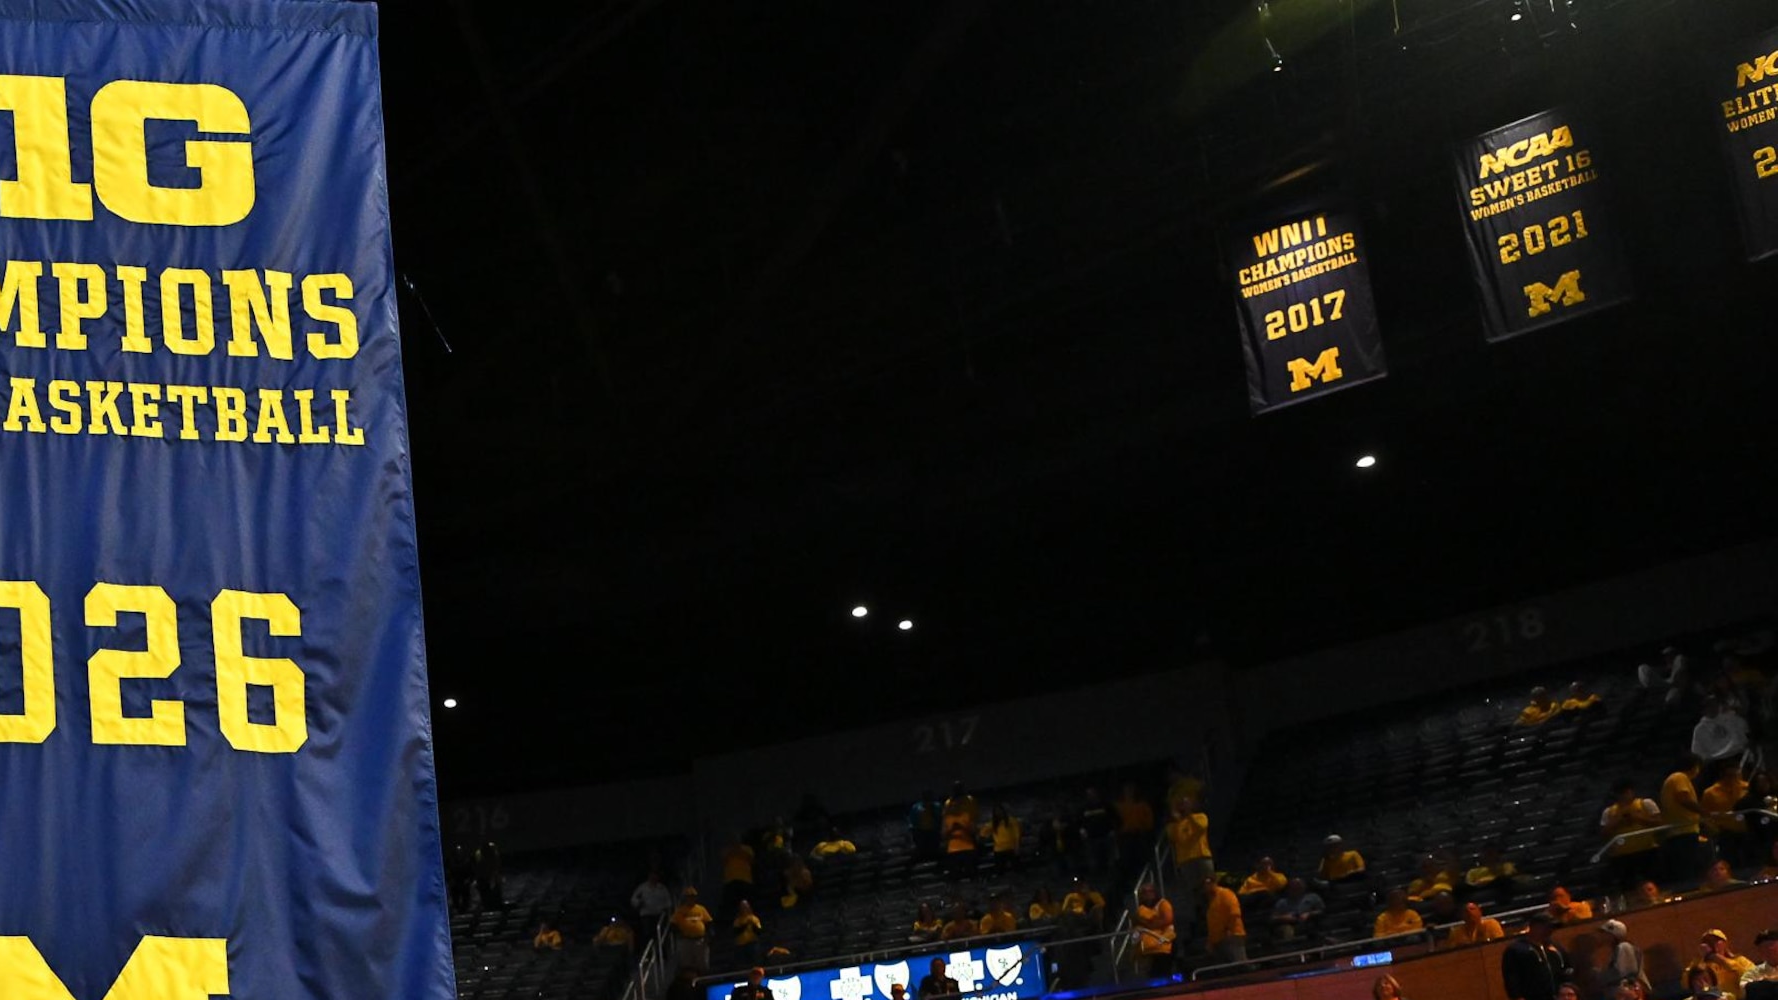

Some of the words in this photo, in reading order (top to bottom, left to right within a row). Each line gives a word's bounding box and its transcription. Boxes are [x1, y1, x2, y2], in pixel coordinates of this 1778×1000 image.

[1470, 160, 1559, 206] SWEET
[1565, 149, 1592, 173] 16
[1479, 125, 1573, 179] NCAA
[1471, 192, 1524, 221] WOMEN'S
[1527, 168, 1598, 202] BASKETBALL
[1239, 232, 1356, 285] CHAMPIONS
[1497, 210, 1588, 264] 2021
[1241, 273, 1291, 298] WOMEN'S
[1292, 252, 1357, 283] BASKETBALL
[1524, 269, 1586, 318] M
[1265, 289, 1346, 341] 2017
[1287, 346, 1343, 392] M
[912, 714, 980, 753] 217
